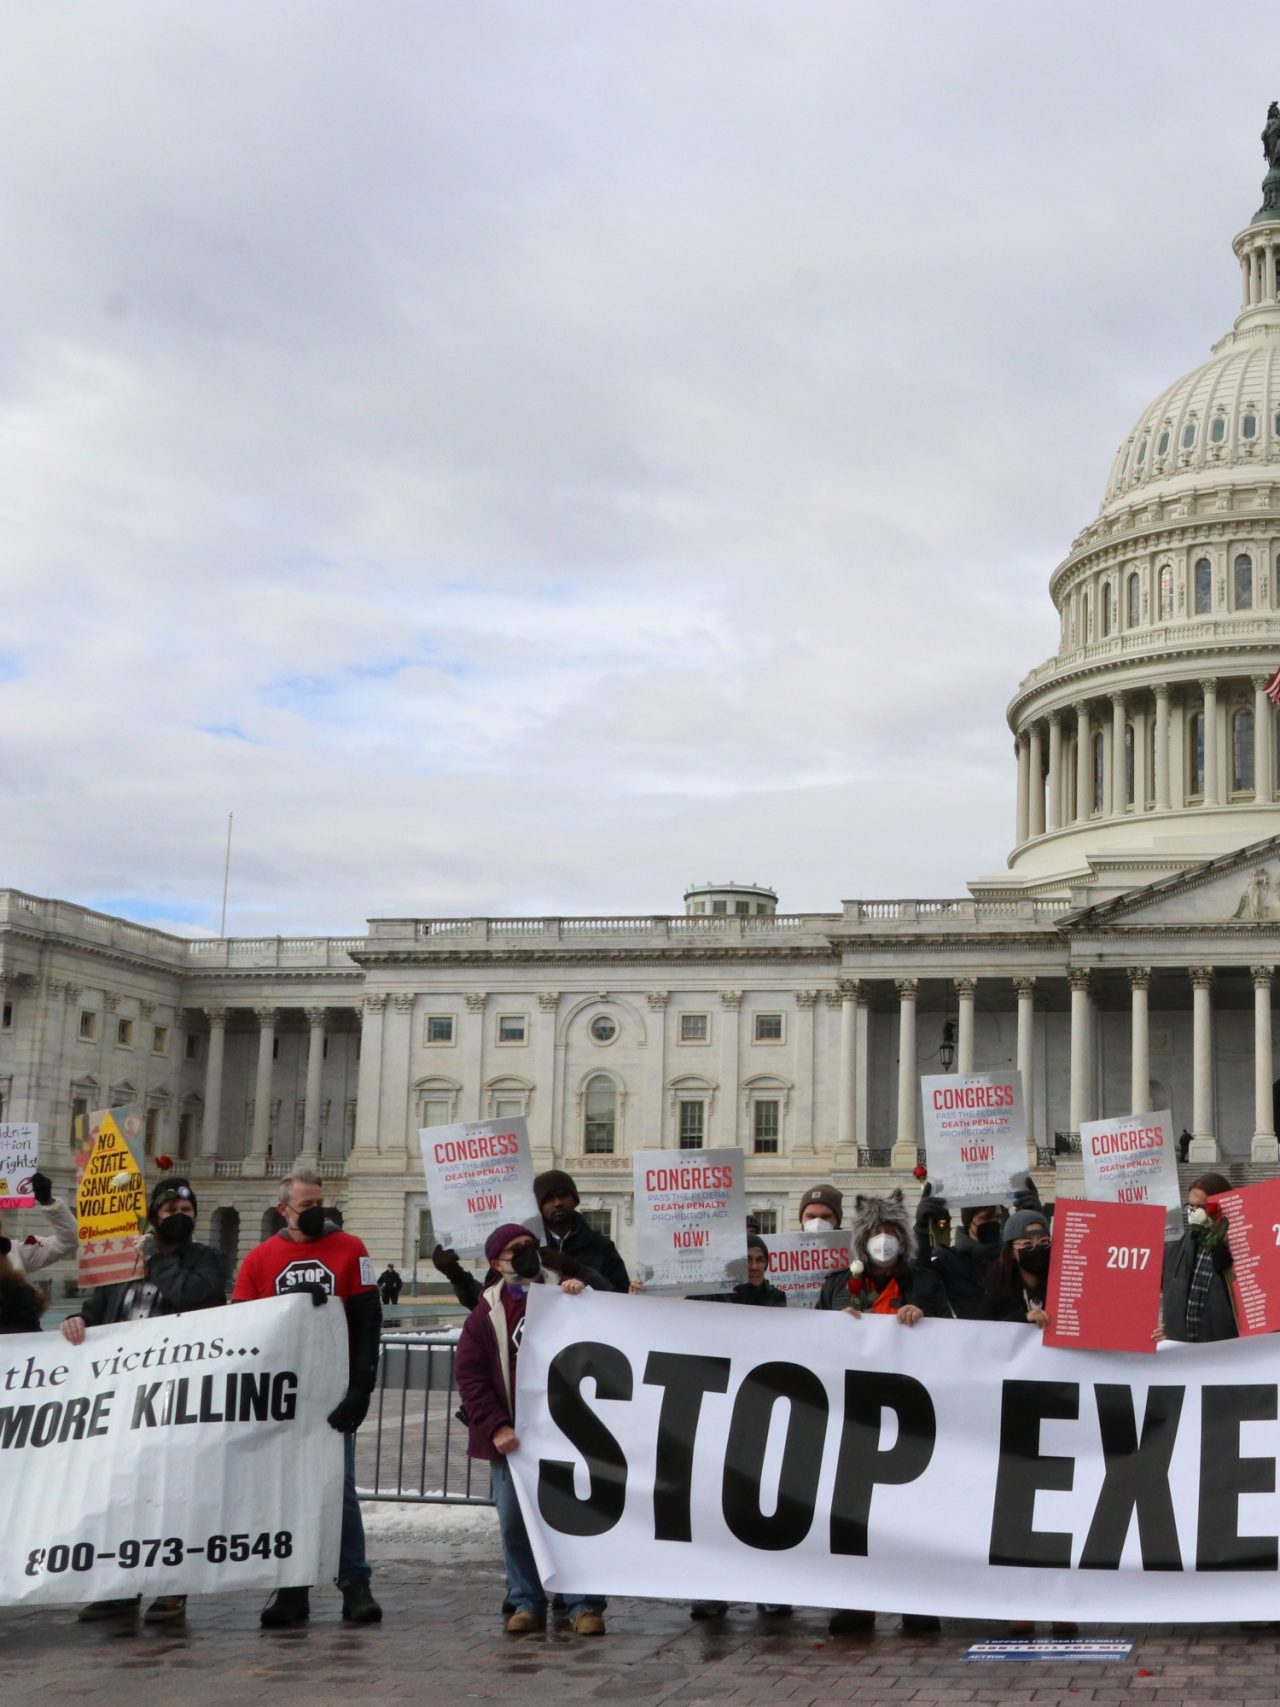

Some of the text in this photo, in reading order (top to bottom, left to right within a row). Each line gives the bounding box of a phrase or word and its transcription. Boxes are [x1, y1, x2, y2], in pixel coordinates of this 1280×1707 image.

[933, 1085, 1015, 1110] CONGRESS
[942, 1118, 1009, 1129] DEATH PENALTY
[98, 1133, 116, 1150] NO
[434, 1133, 519, 1164] CONGRESS
[1091, 1126, 1164, 1156] CONGRESS
[90, 1151, 128, 1175] STATE
[961, 1145, 995, 1162] NOW!
[445, 1166, 515, 1182] DEATH PENALTY
[1100, 1158, 1160, 1173] DEATH PENALTY
[645, 1166, 733, 1192] CONGRESS
[79, 1191, 143, 1217] VIOLENCE
[467, 1194, 503, 1214] NOW!
[648, 1193, 670, 1201] PASS
[691, 1191, 731, 1200] FEDERAL
[1117, 1185, 1149, 1203] NOW!
[652, 1212, 710, 1221] PROHIBITION
[654, 1201, 727, 1212] DEATH PENALTY
[673, 1231, 710, 1249] NOW!
[768, 1247, 849, 1273] CONGRESS
[1106, 1246, 1151, 1270] 2017
[285, 1268, 325, 1286] STOP
[777, 1283, 805, 1291] DEATH
[5, 1336, 260, 1391] the victims...
[0, 1372, 298, 1449] MORE KILLING
[537, 1341, 937, 1557] STOP
[25, 1532, 293, 1576] 800-973-6548
